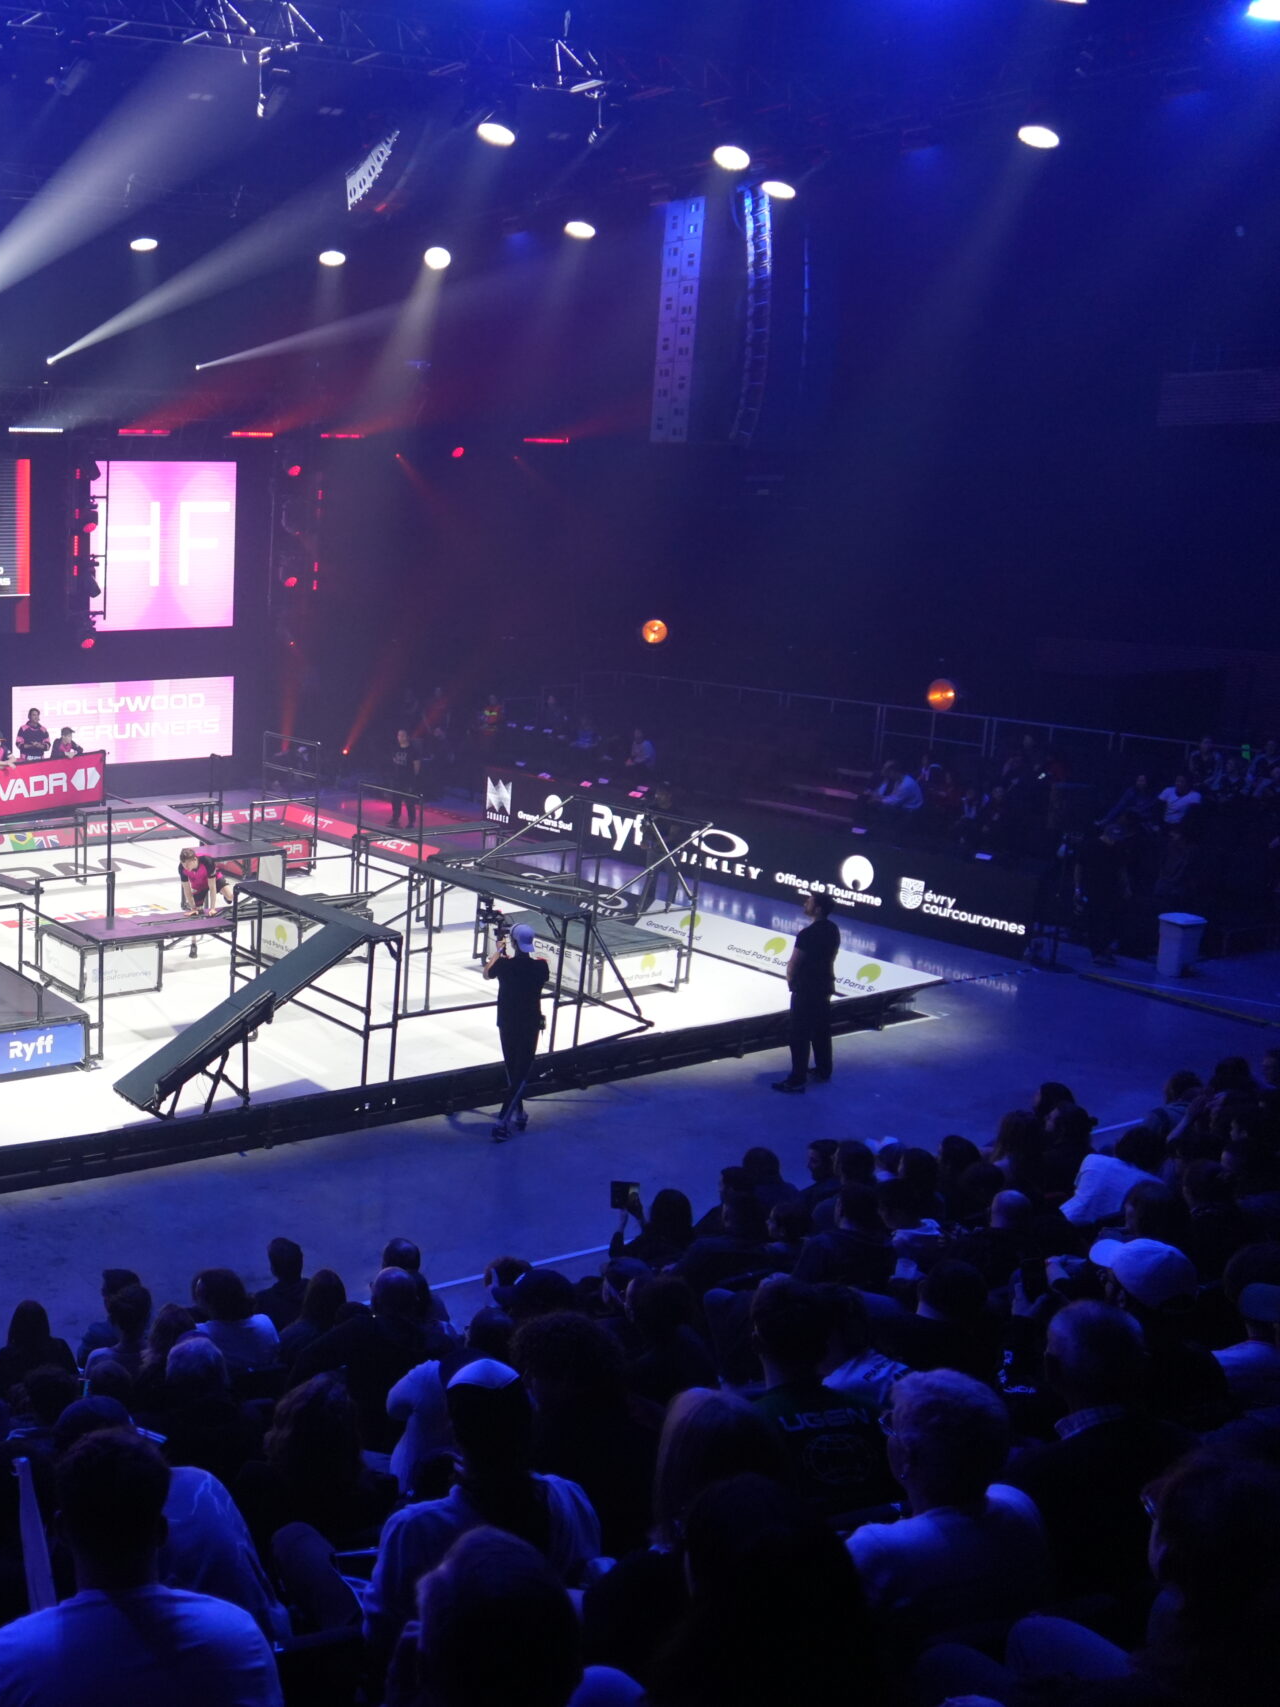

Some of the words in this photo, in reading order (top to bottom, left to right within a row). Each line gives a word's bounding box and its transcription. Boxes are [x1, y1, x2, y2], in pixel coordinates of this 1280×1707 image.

[43, 693, 206, 717] HOLLYWOOD
[86, 819, 158, 835] WORLD
[239, 808, 278, 821] TAG
[558, 820, 573, 831] Sud
[775, 872, 809, 889] Office
[810, 880, 826, 893] de
[827, 884, 883, 907] Tourisme
[924, 889, 957, 908] évry
[646, 920, 669, 931] Grand
[669, 926, 686, 937] Paris
[922, 903, 1026, 936] courcouronnes
[727, 944, 751, 957] Grand
[752, 951, 771, 962] Paris
[772, 957, 788, 967] Sud
[843, 978, 865, 991] Paris
[9, 1034, 53, 1062] Ryff
